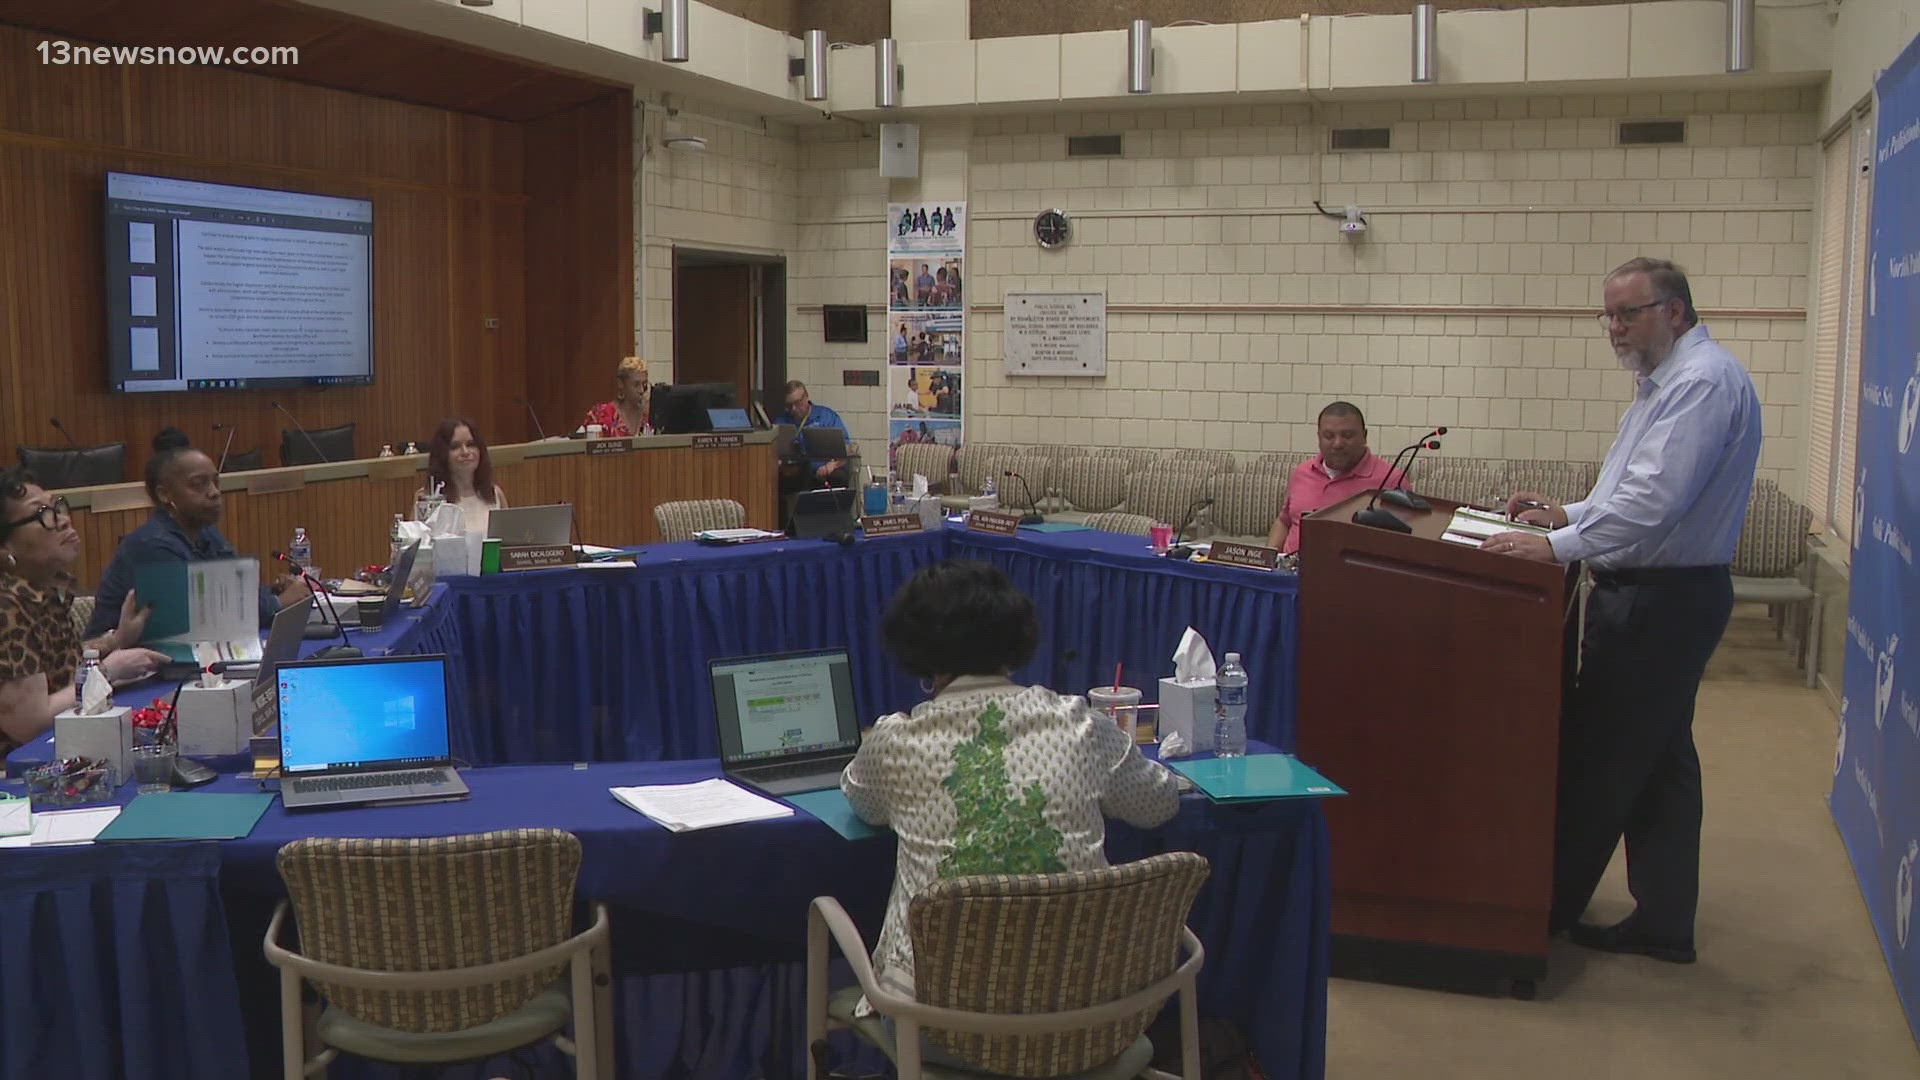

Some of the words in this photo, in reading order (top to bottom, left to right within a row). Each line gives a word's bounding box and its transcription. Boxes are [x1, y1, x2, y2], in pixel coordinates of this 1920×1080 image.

[510, 551, 530, 559] SARAH
[1224, 546, 1246, 556] JASON
[1246, 550, 1262, 559] INGE
